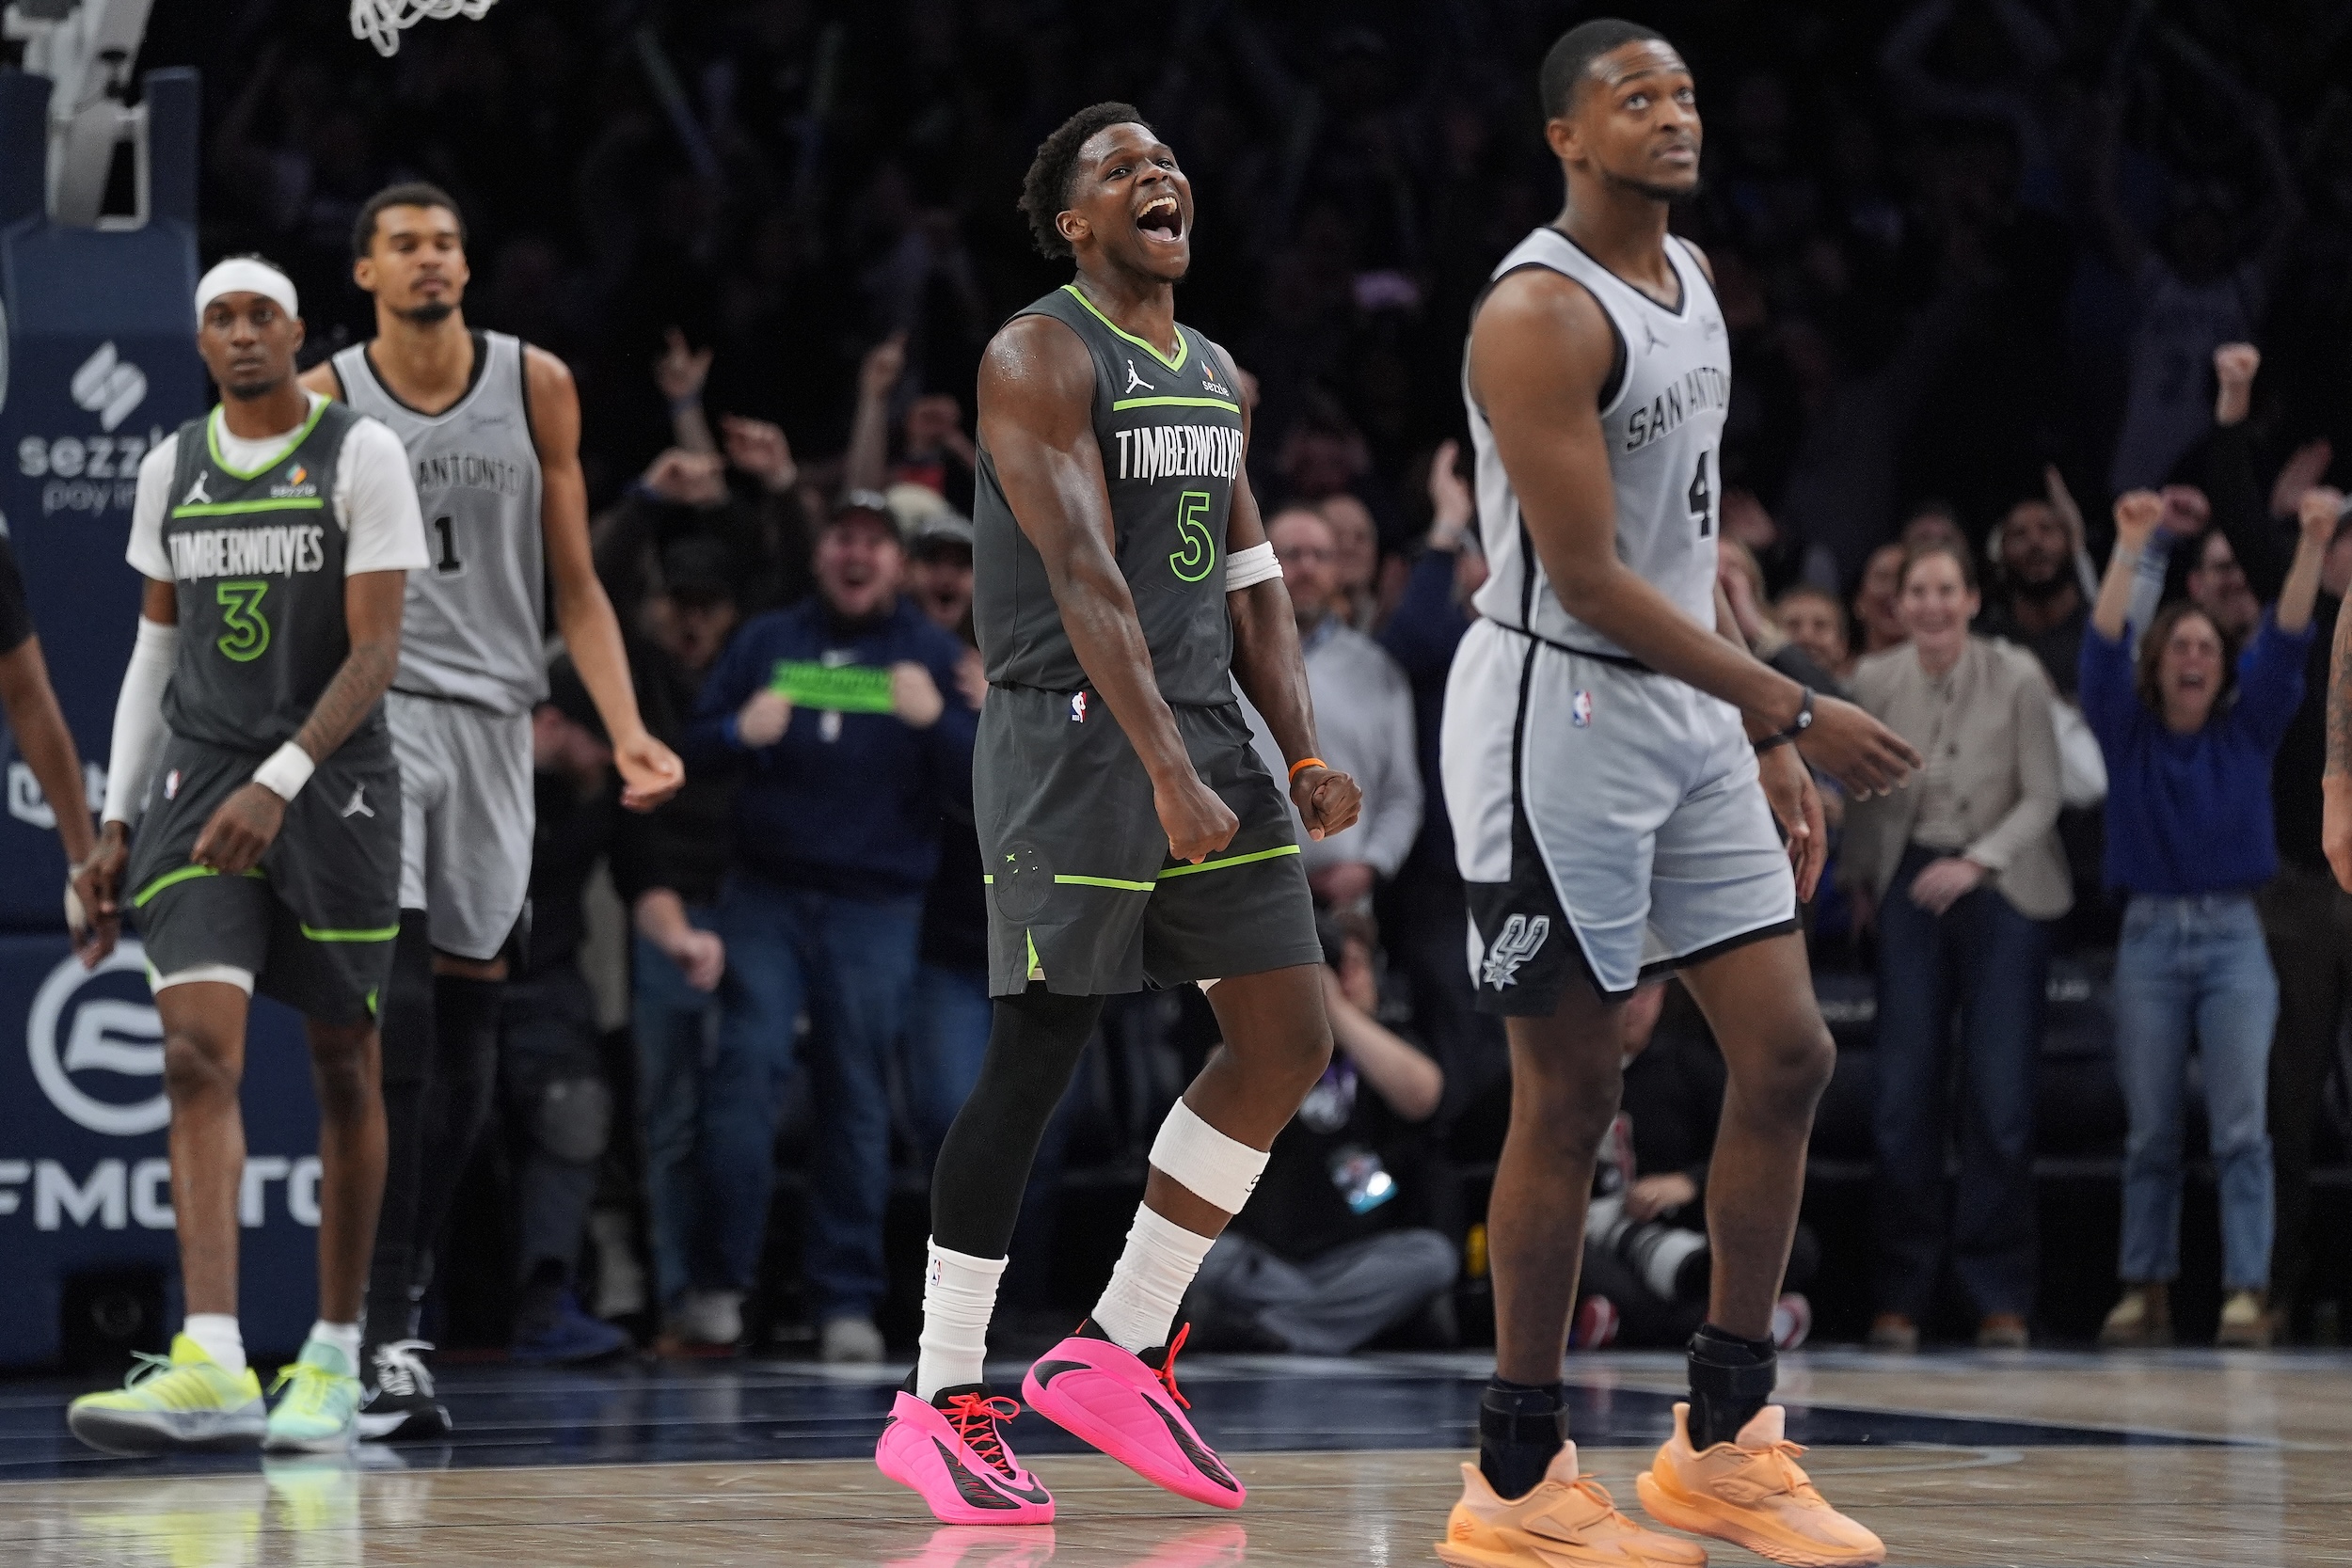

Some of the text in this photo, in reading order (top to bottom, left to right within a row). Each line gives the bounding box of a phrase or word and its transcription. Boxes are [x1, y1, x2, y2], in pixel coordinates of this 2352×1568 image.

[1201, 380, 1230, 397] sezzle
[1626, 380, 1683, 451] SAN
[18, 424, 165, 478] sezz
[1116, 425, 1244, 486] TIMBERWOLVE
[1688, 449, 1713, 539] 4
[167, 524, 325, 585] TIMBERWOLVES
[433, 515, 463, 576] 1
[1169, 491, 1216, 582] 5
[216, 579, 271, 661] 3
